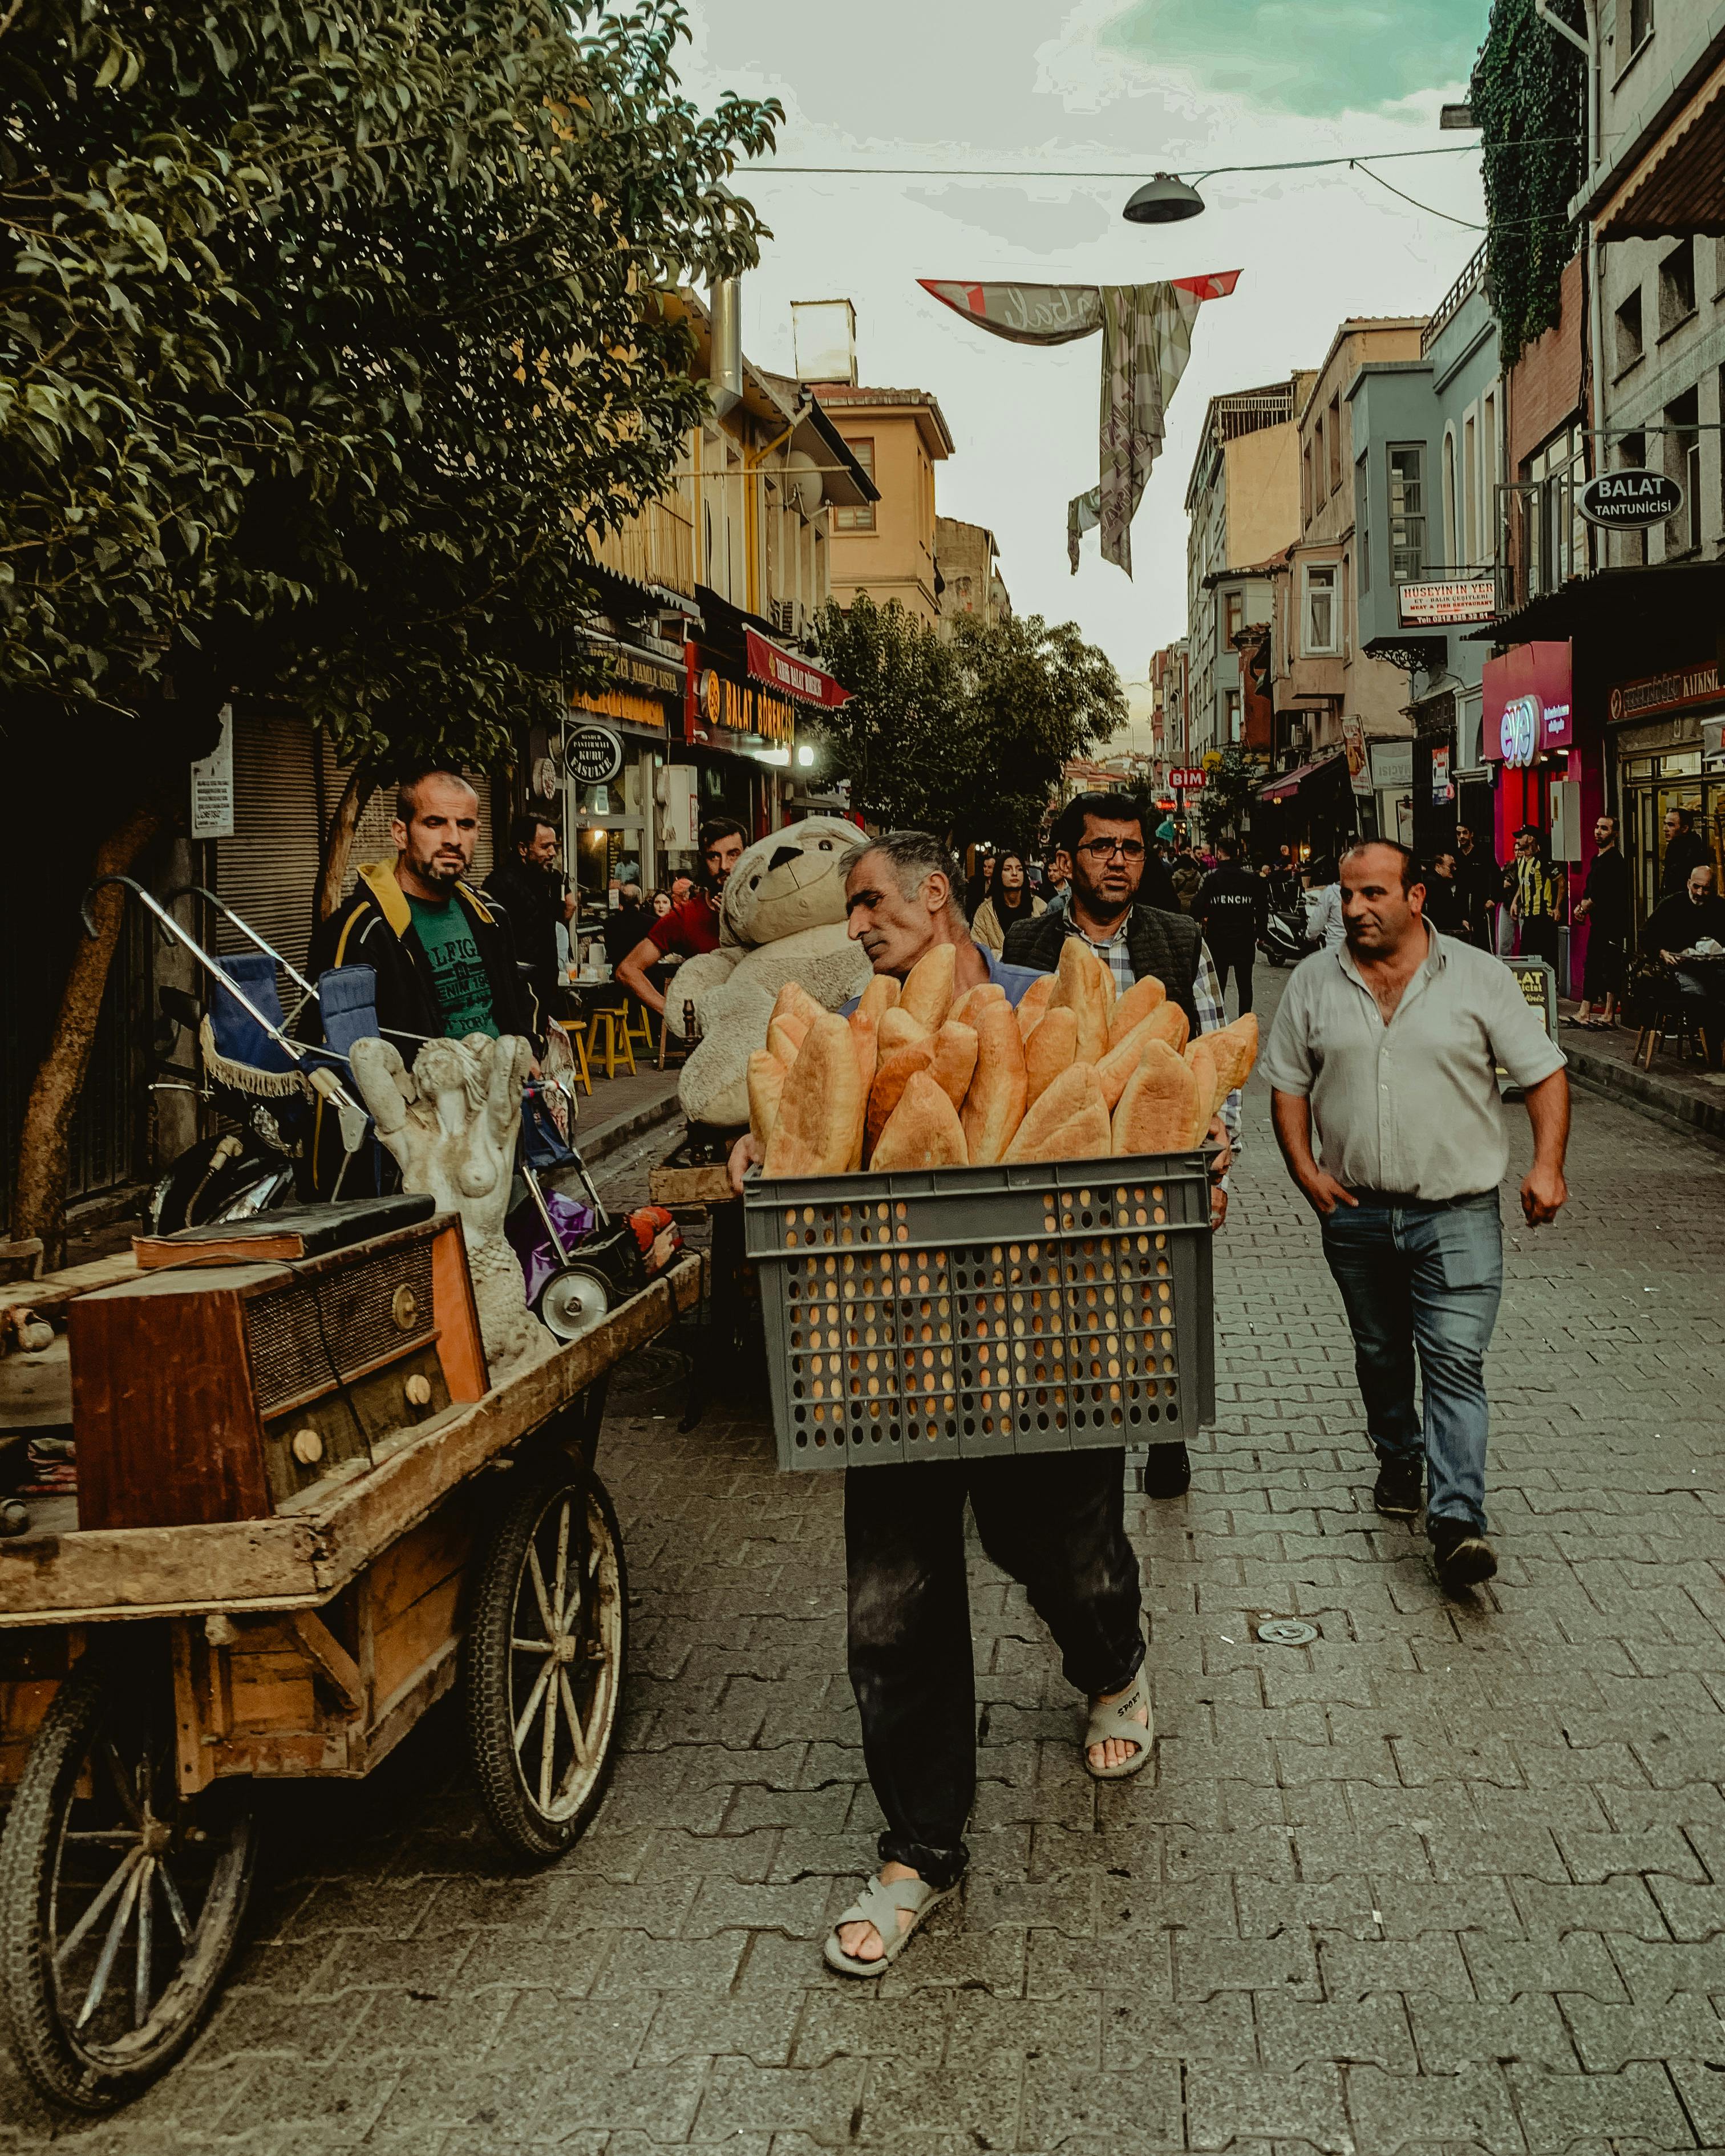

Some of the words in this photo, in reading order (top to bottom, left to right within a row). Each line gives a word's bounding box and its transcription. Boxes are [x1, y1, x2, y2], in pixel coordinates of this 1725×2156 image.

[1599, 477, 1665, 498] BALAT
[1595, 500, 1671, 516] TANTUNİCİSİ
[659, 670, 678, 692] USTA
[726, 680, 753, 731] BALAT
[580, 751, 604, 760] KURU
[570, 756, 612, 778] FASULYE
[1117, 1692, 1140, 1717] SPORT
